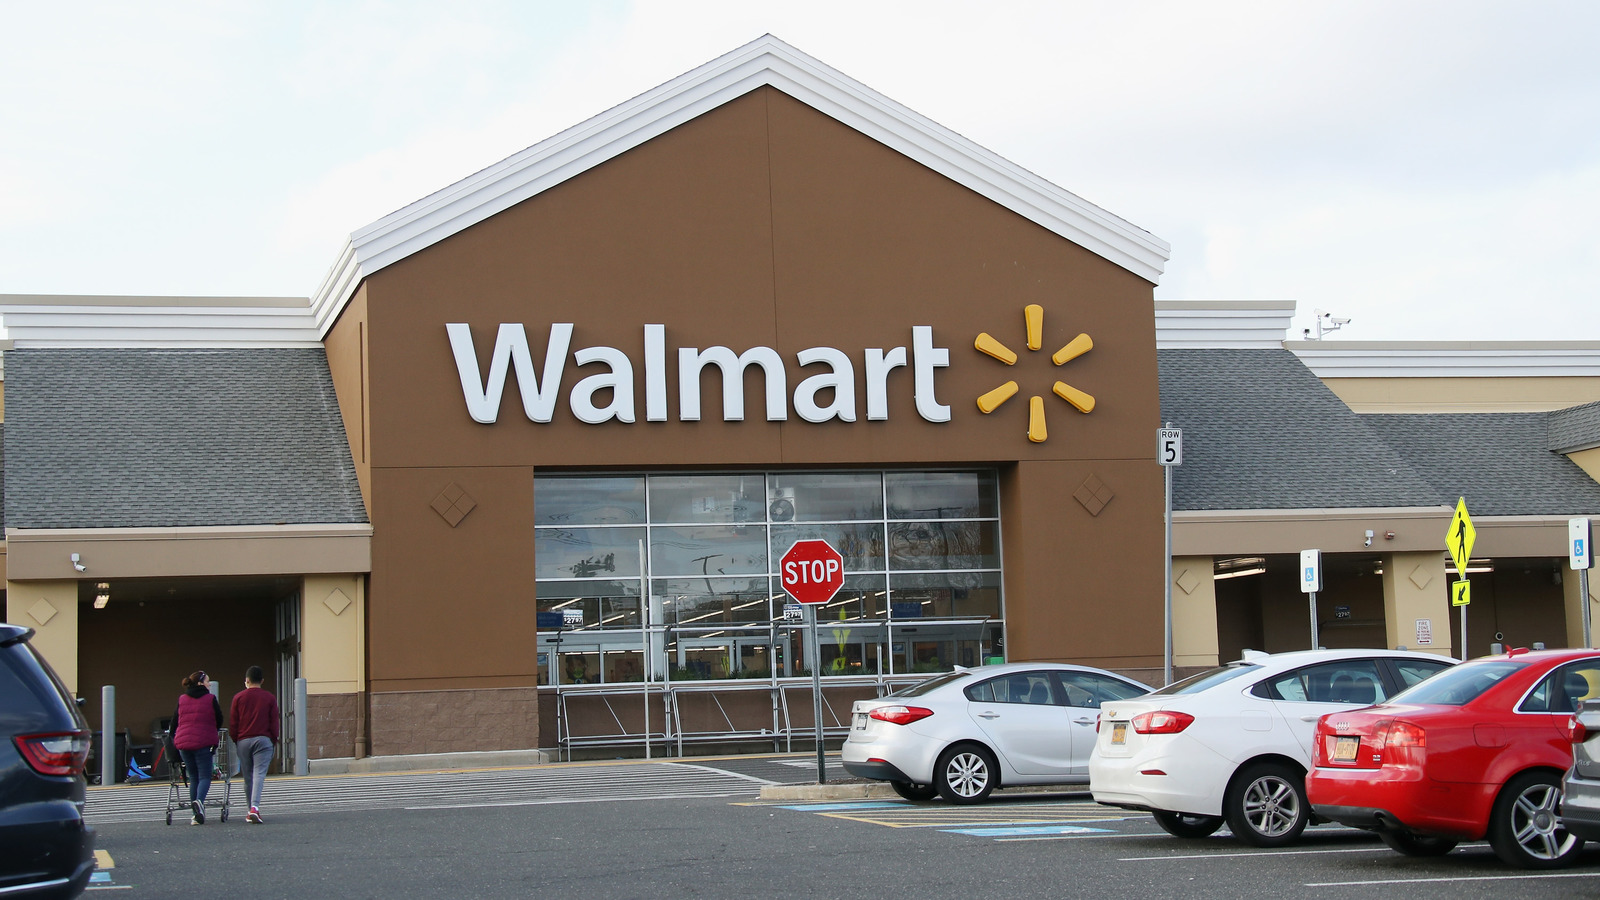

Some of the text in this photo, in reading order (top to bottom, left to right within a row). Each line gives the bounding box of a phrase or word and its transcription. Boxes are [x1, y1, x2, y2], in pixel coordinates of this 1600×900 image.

[445, 323, 951, 424] Walmart
[1161, 430, 1179, 438] ROW
[1165, 441, 1176, 463] 5
[785, 559, 839, 585] STOP
